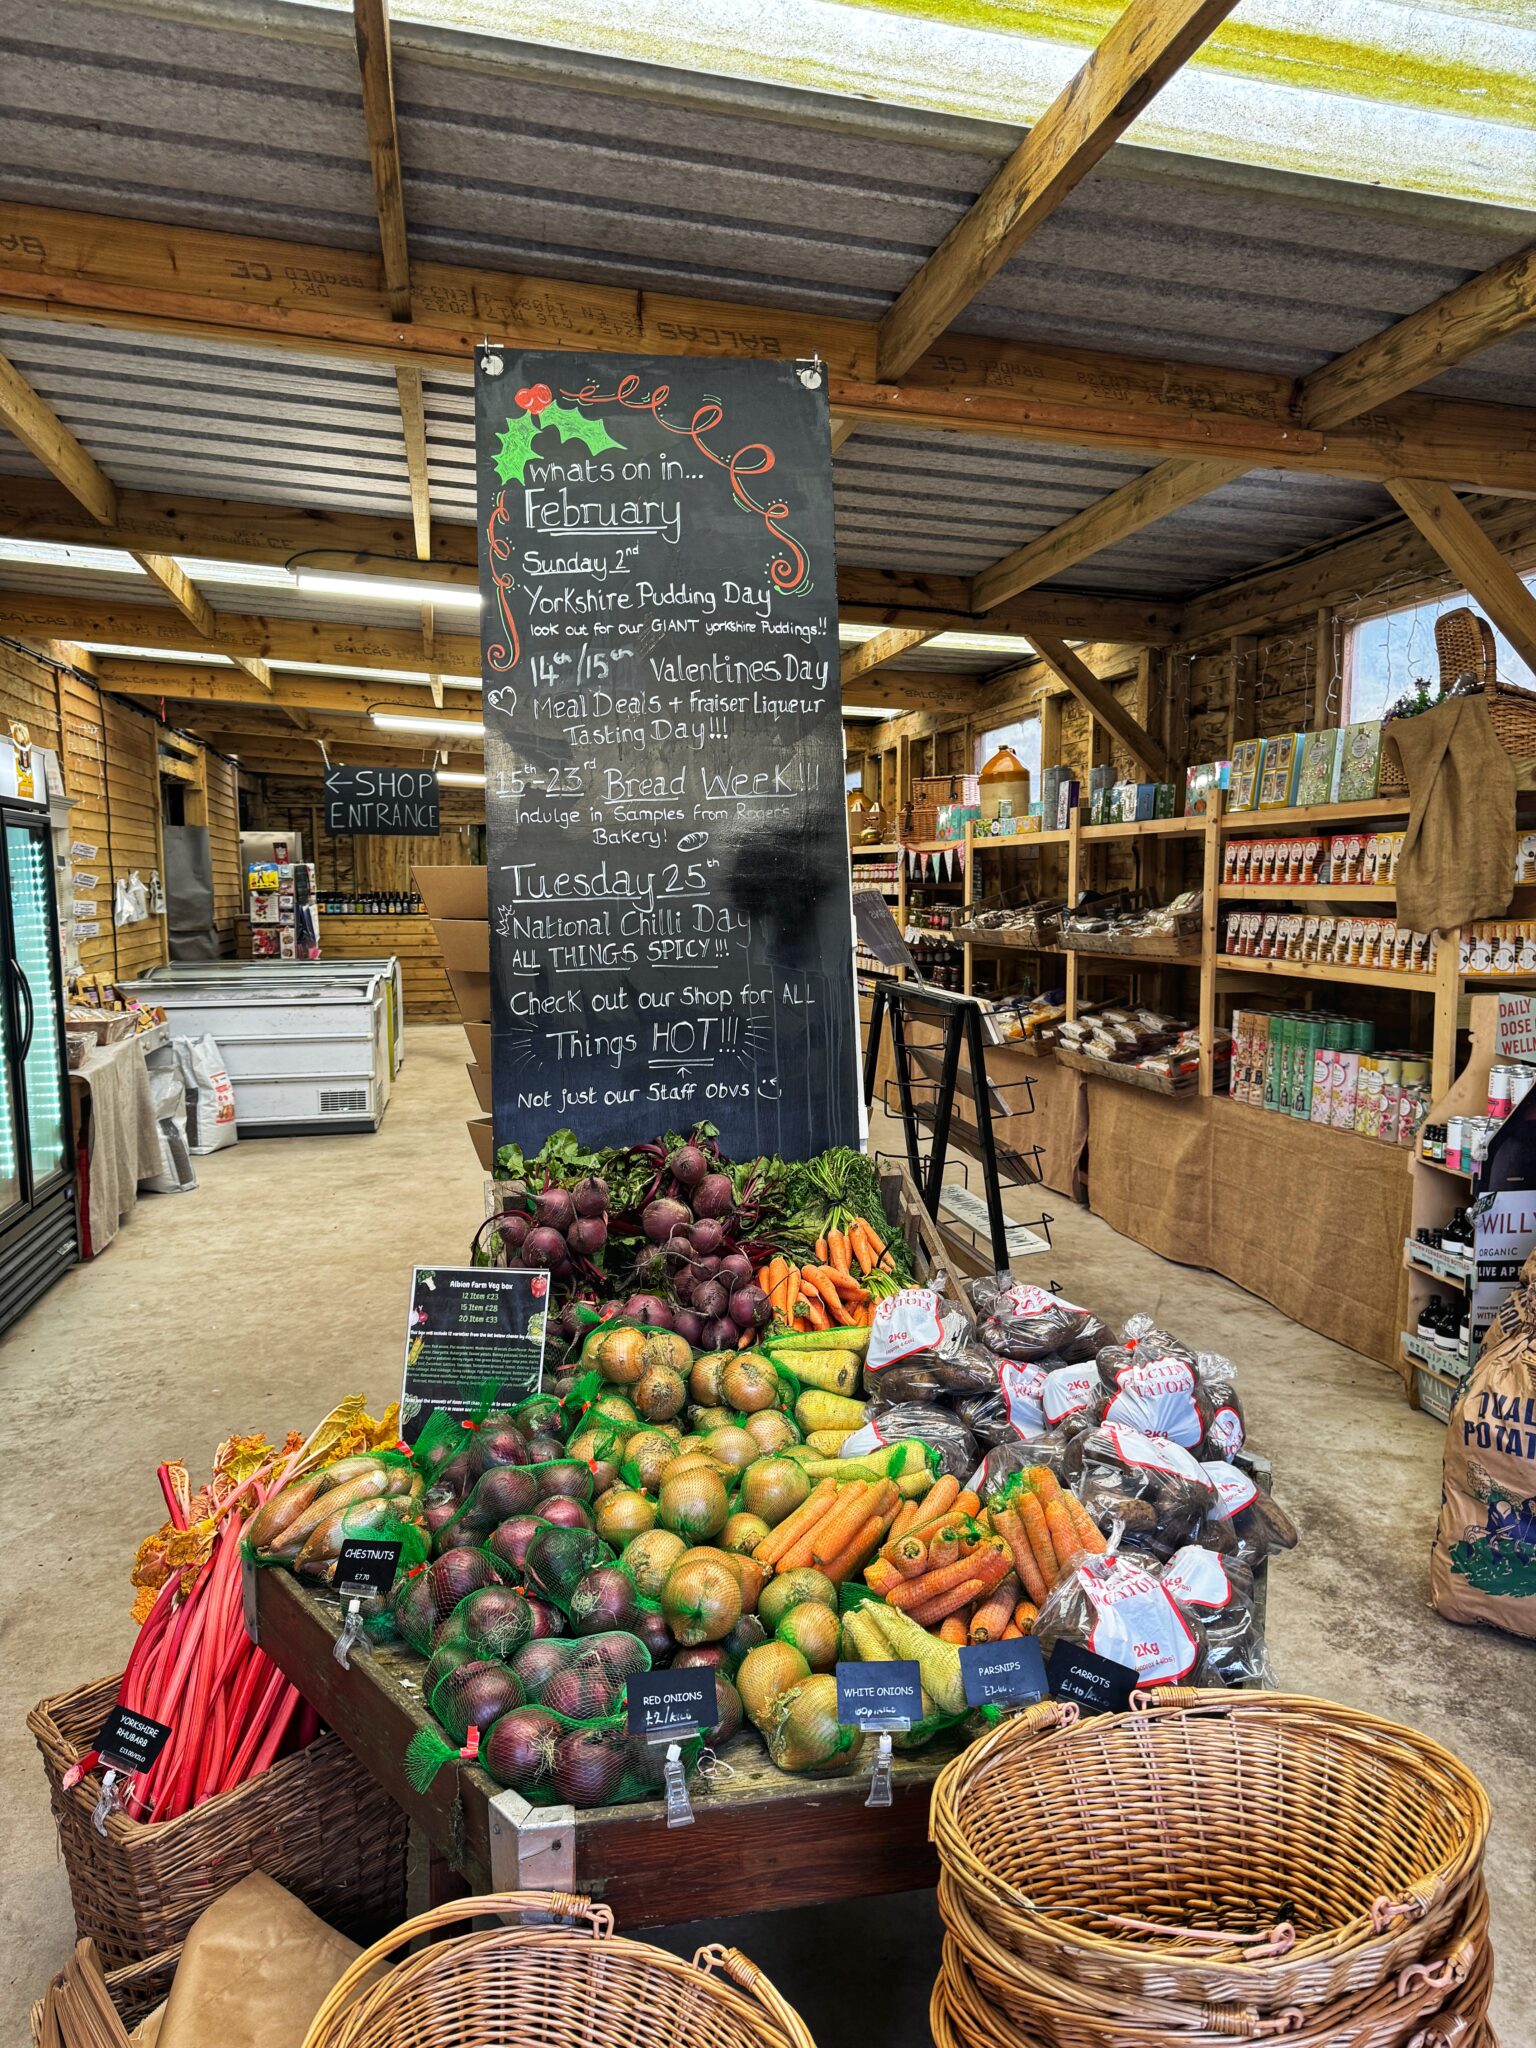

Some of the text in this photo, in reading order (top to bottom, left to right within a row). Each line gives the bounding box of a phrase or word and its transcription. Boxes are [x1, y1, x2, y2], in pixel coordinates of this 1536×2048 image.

[224, 259, 272, 281] CE
[657, 322, 781, 354] BALCAS
[529, 453, 704, 484] whats on in...
[525, 488, 681, 543] February
[522, 544, 640, 581] Sunday 2nd
[523, 582, 772, 617] Yorkshire Pudding Day
[565, 623, 589, 636] out
[593, 622, 611, 636] for
[619, 623, 643, 634] our
[651, 619, 699, 632] GIANT
[334, 643, 392, 657] BALCAS
[650, 654, 781, 683] Valentines
[785, 653, 829, 690] Day
[533, 690, 825, 722] Meal Deals + Fraiser Liqueur
[563, 717, 728, 751] Tasting Day!!!
[355, 771, 433, 798] SHOP
[602, 767, 686, 800] Bread
[331, 802, 439, 829] ENTRANCE
[515, 809, 580, 829] Indulge
[591, 808, 603, 822] in
[614, 806, 684, 827] Samples
[694, 807, 728, 821] from
[501, 858, 720, 913] Tuesday 25th
[513, 904, 751, 949] National Chilli Day
[513, 938, 730, 969] ALL THINGS SPICY!!!
[592, 987, 628, 1010] out
[639, 992, 674, 1008] our
[741, 985, 772, 1007] for
[782, 983, 815, 1005] ALL
[1500, 999, 1531, 1018] DAILY
[1501, 1019, 1532, 1036] DOSE
[546, 1016, 738, 1069] Things HOT!!!
[518, 1090, 552, 1109] Not
[557, 1087, 597, 1113] just
[604, 1088, 640, 1105] our
[649, 1082, 697, 1101] Staff
[1479, 1248, 1518, 1256] ORGANIC
[1478, 1267, 1496, 1276] LIVE
[450, 1280, 513, 1291] Albion Farm Veg box
[889, 1332, 908, 1343] 2Kg
[1067, 1380, 1090, 1391] 2Kg
[345, 1549, 394, 1560] CHESTNUTS
[1133, 1642, 1160, 1658] 2Kg
[978, 1661, 1021, 1677] PARSNIPS
[1070, 1666, 1111, 1689] CARROTS
[643, 1691, 703, 1706] RED ONIONS
[844, 1686, 914, 1697] WHITE ONIONS
[116, 1727, 148, 1747] RHUBARB
[120, 1715, 159, 1738] YORKSHIRE
